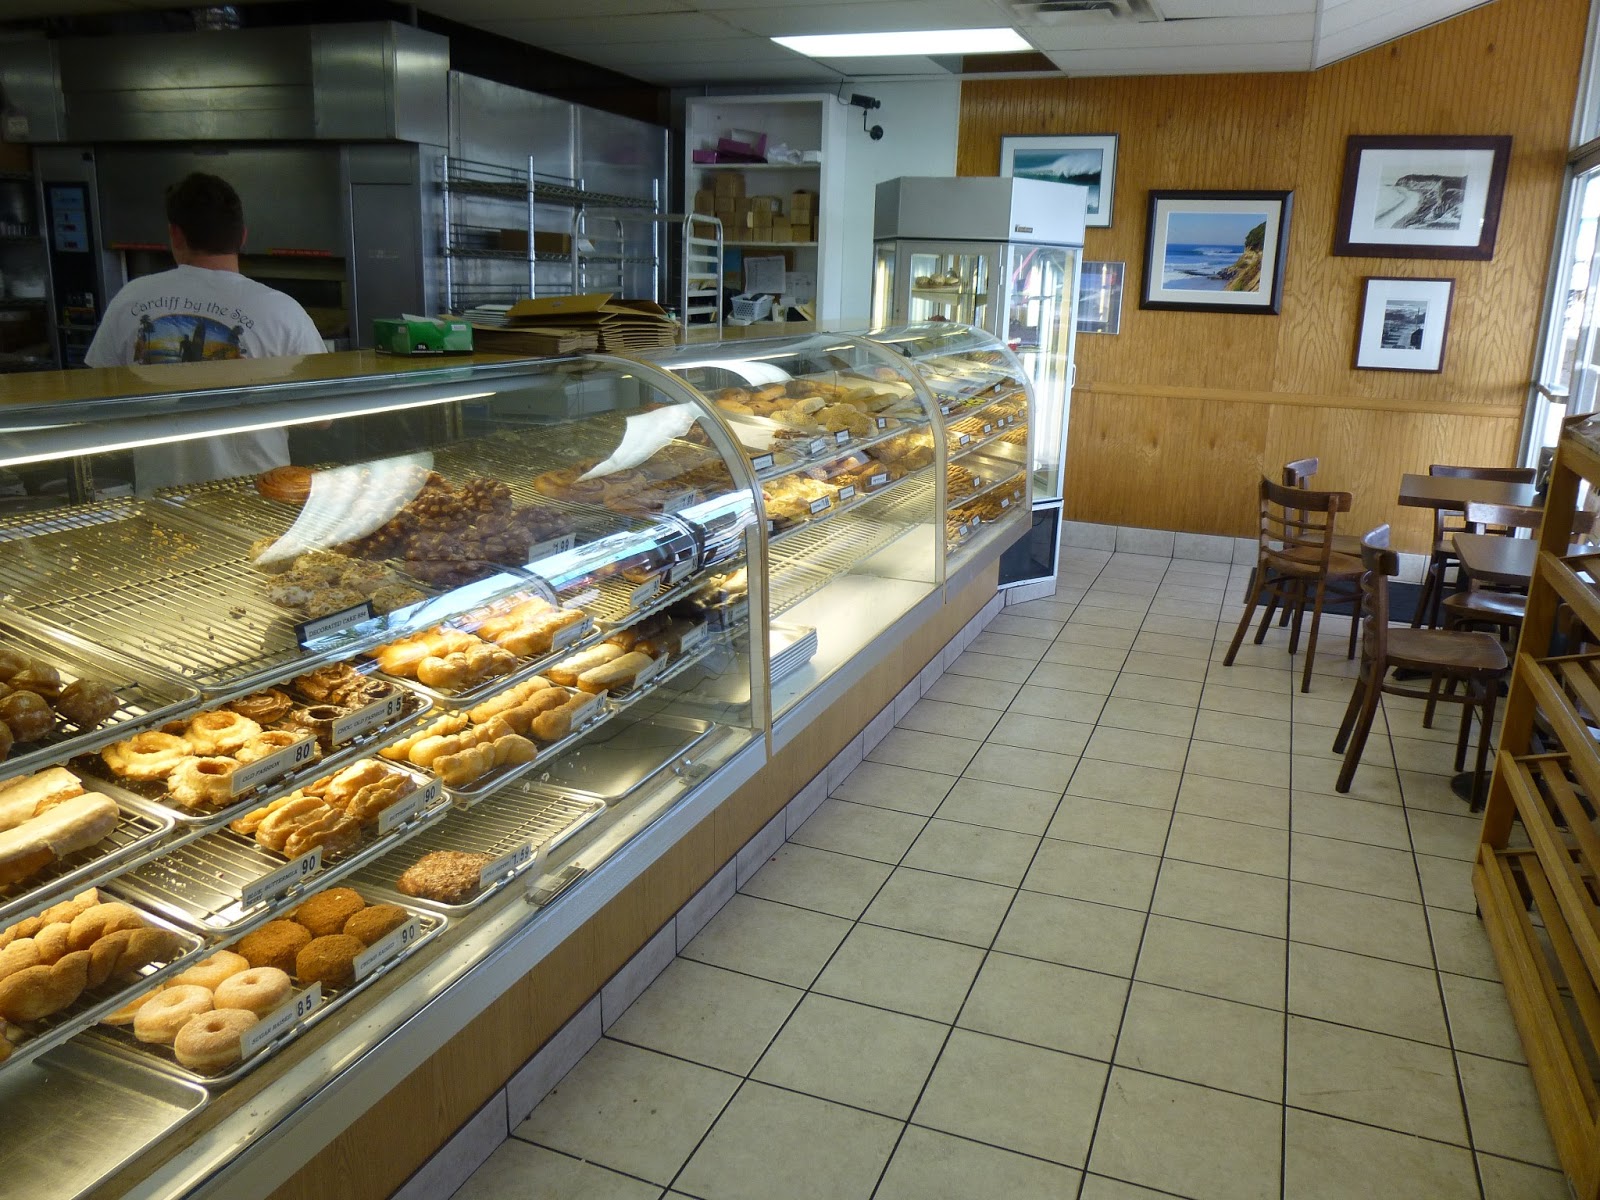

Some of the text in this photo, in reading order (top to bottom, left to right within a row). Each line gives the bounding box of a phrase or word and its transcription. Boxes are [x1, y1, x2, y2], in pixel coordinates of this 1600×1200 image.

[131, 297, 254, 329] Cardiff by the Sea
[309, 620, 342, 637] DECORATED
[342, 614, 356, 625] CAKE
[387, 697, 402, 716] 85
[242, 743, 310, 783] OLD FASHION 80
[425, 786, 436, 803] 90
[302, 855, 316, 875] 90
[402, 925, 415, 944] 90
[297, 994, 312, 1017] 85
